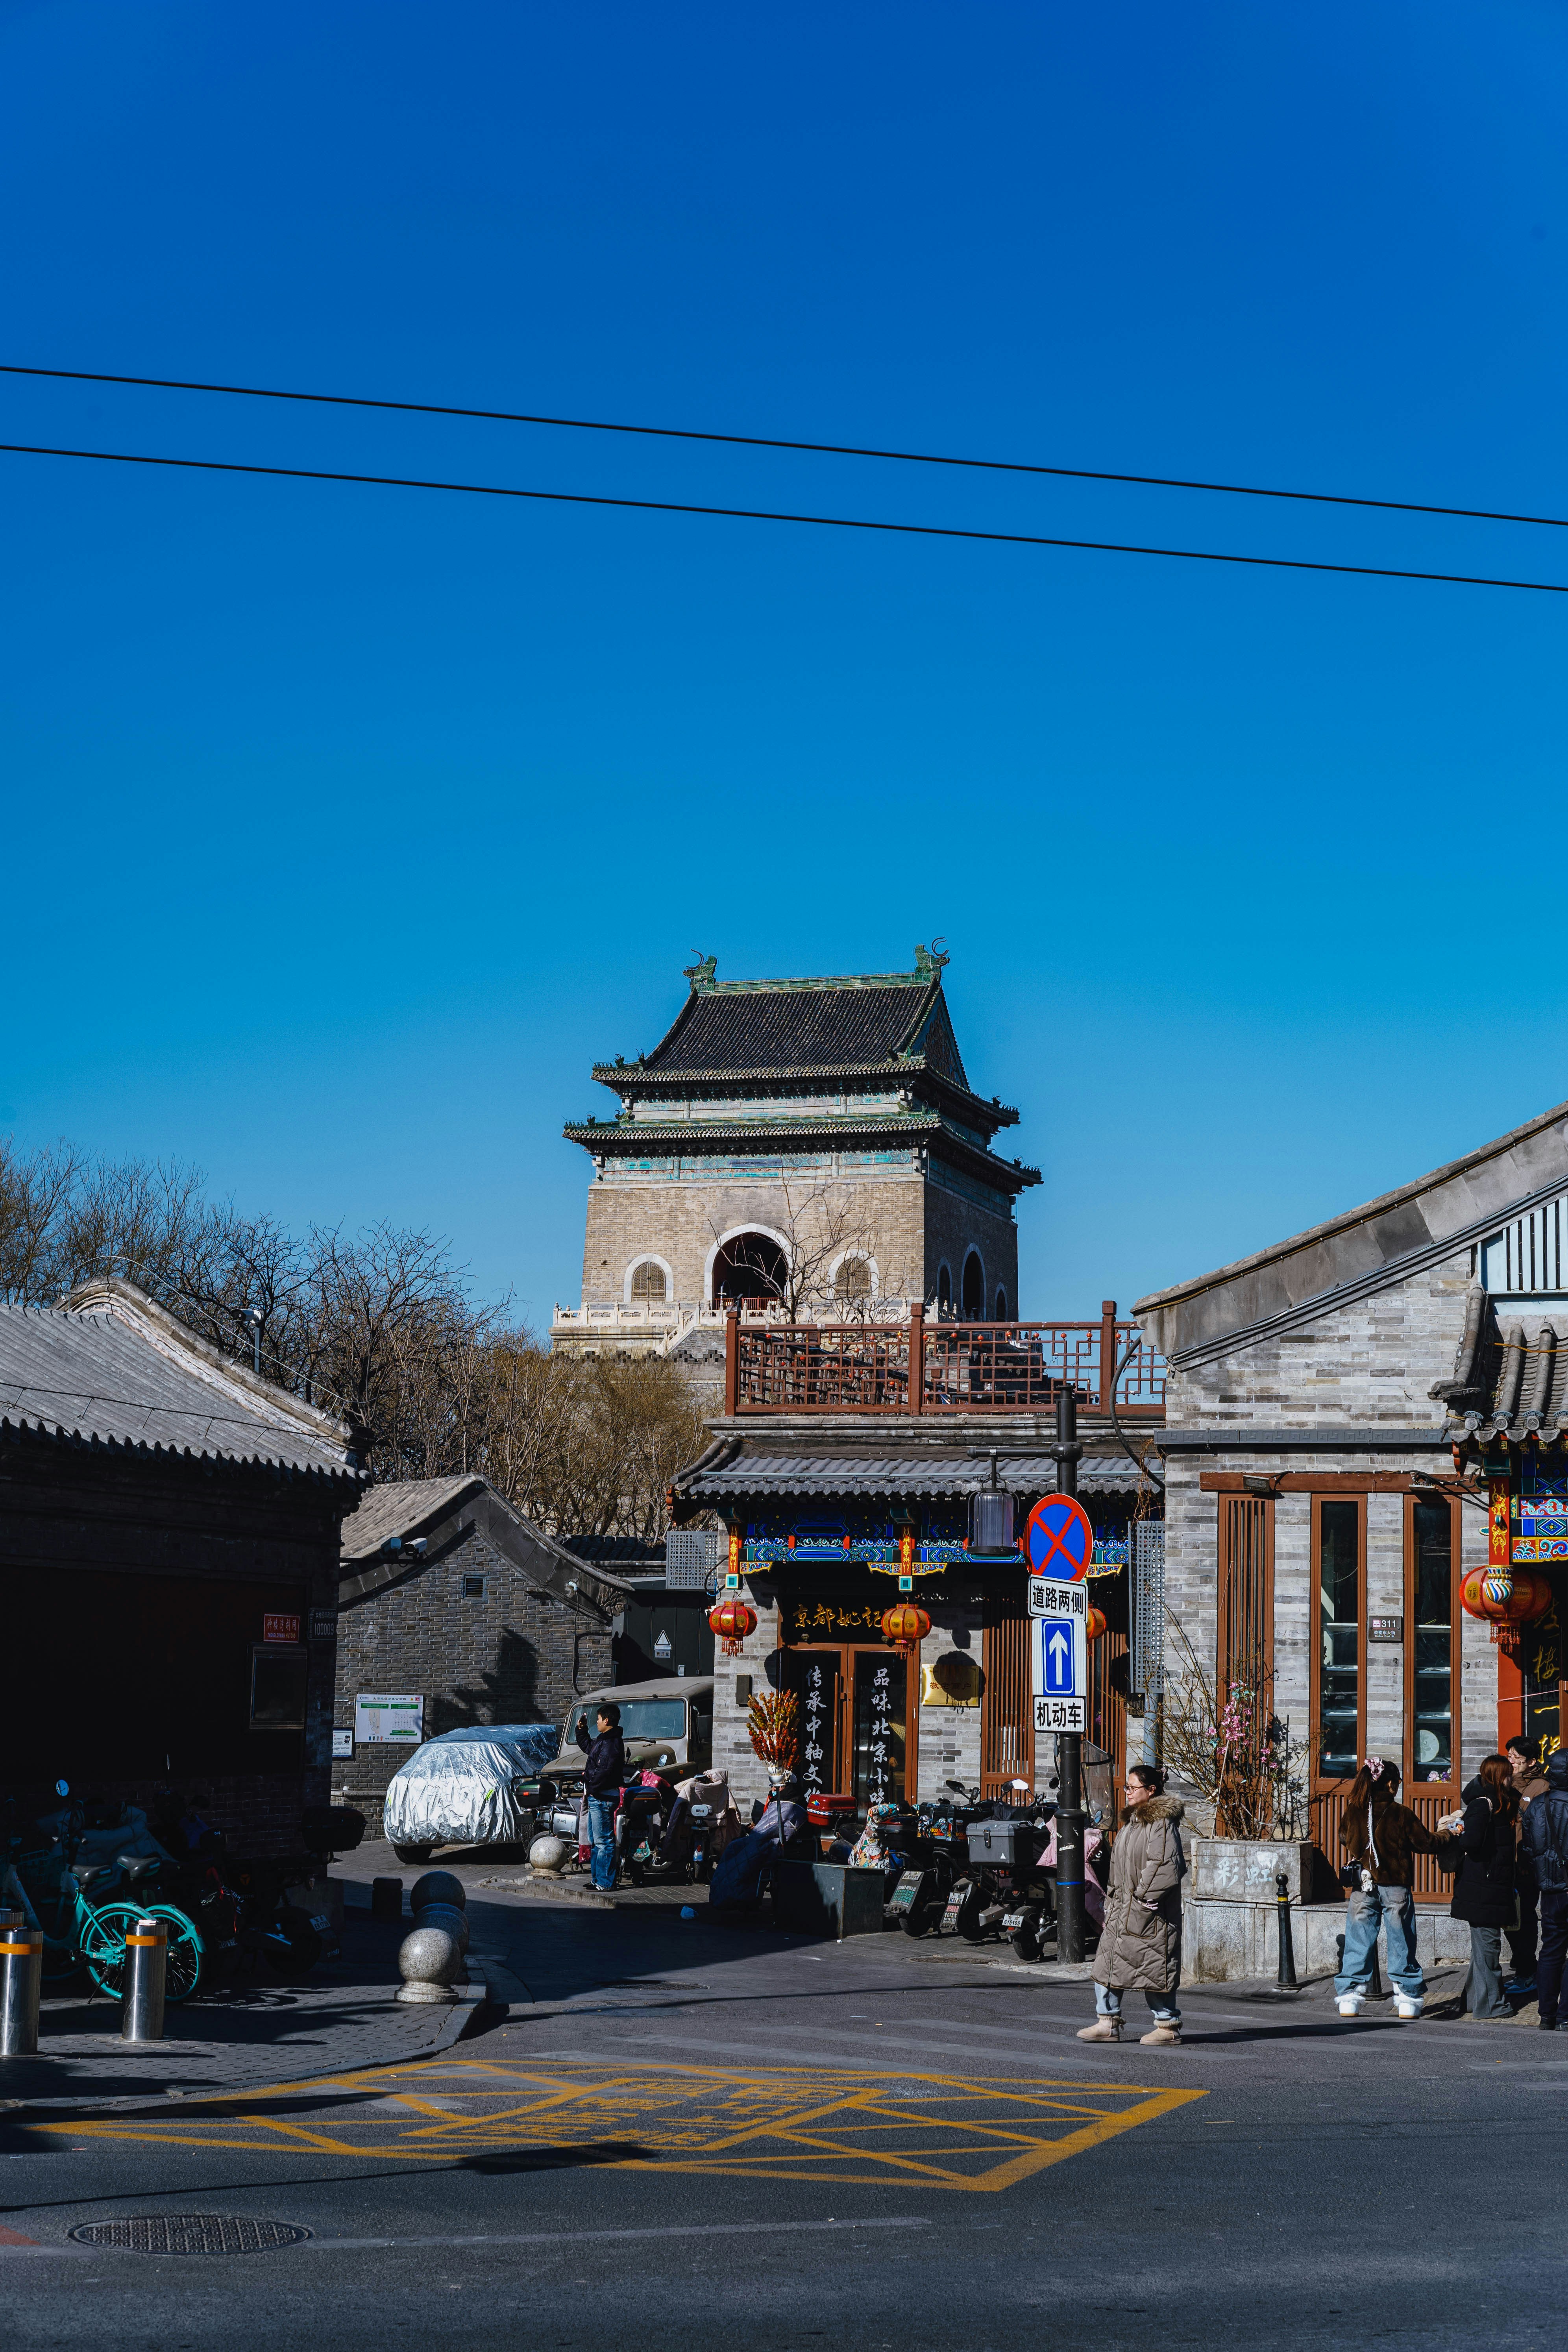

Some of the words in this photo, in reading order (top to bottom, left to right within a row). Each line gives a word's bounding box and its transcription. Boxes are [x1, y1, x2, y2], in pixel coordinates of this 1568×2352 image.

[1032, 1585, 1084, 1614] 道路两侧
[267, 1618, 297, 1632] 钟楼湾胡同
[314, 1623, 334, 1636] 100009
[793, 1602, 882, 1633] 京都姚记
[1037, 1701, 1082, 1728] 机动车
